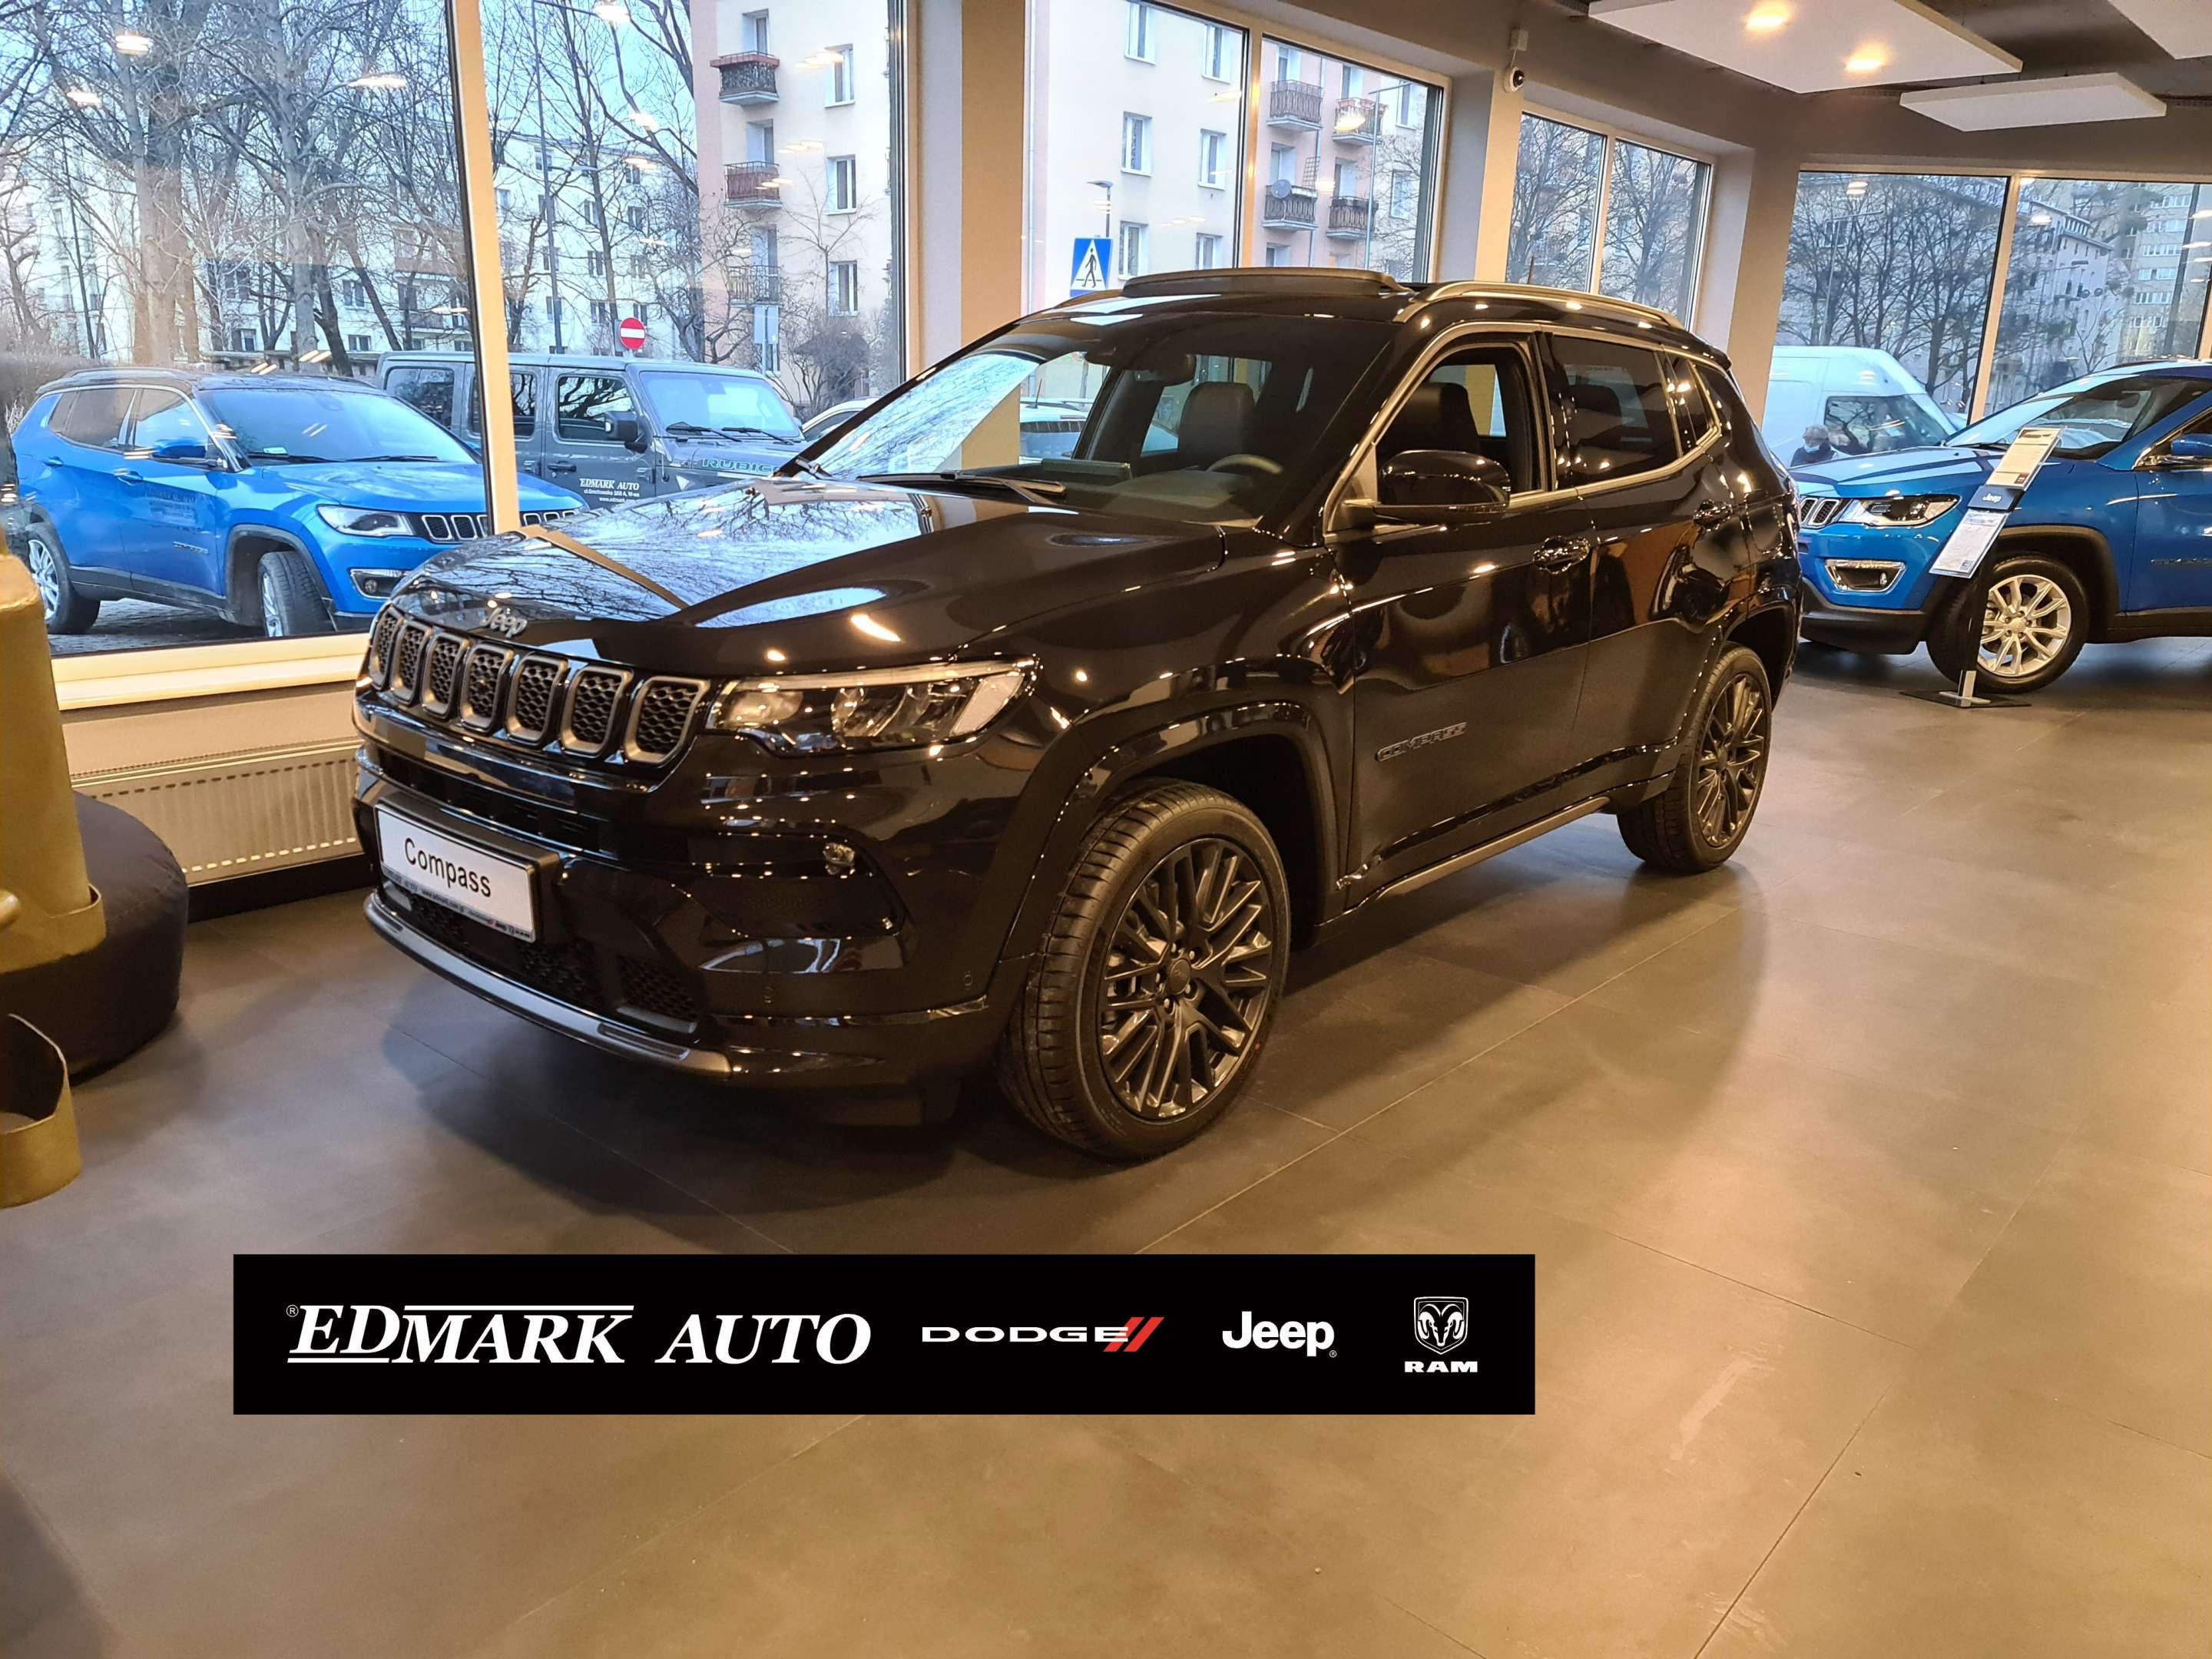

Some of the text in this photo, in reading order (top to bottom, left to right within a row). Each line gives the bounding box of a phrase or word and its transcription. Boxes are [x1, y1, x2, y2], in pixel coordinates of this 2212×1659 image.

[579, 478, 640, 491] EDMARK AUTO
[1982, 492, 2002, 504] Jeep
[478, 608, 528, 639] Jeep
[405, 837, 492, 898] Compass
